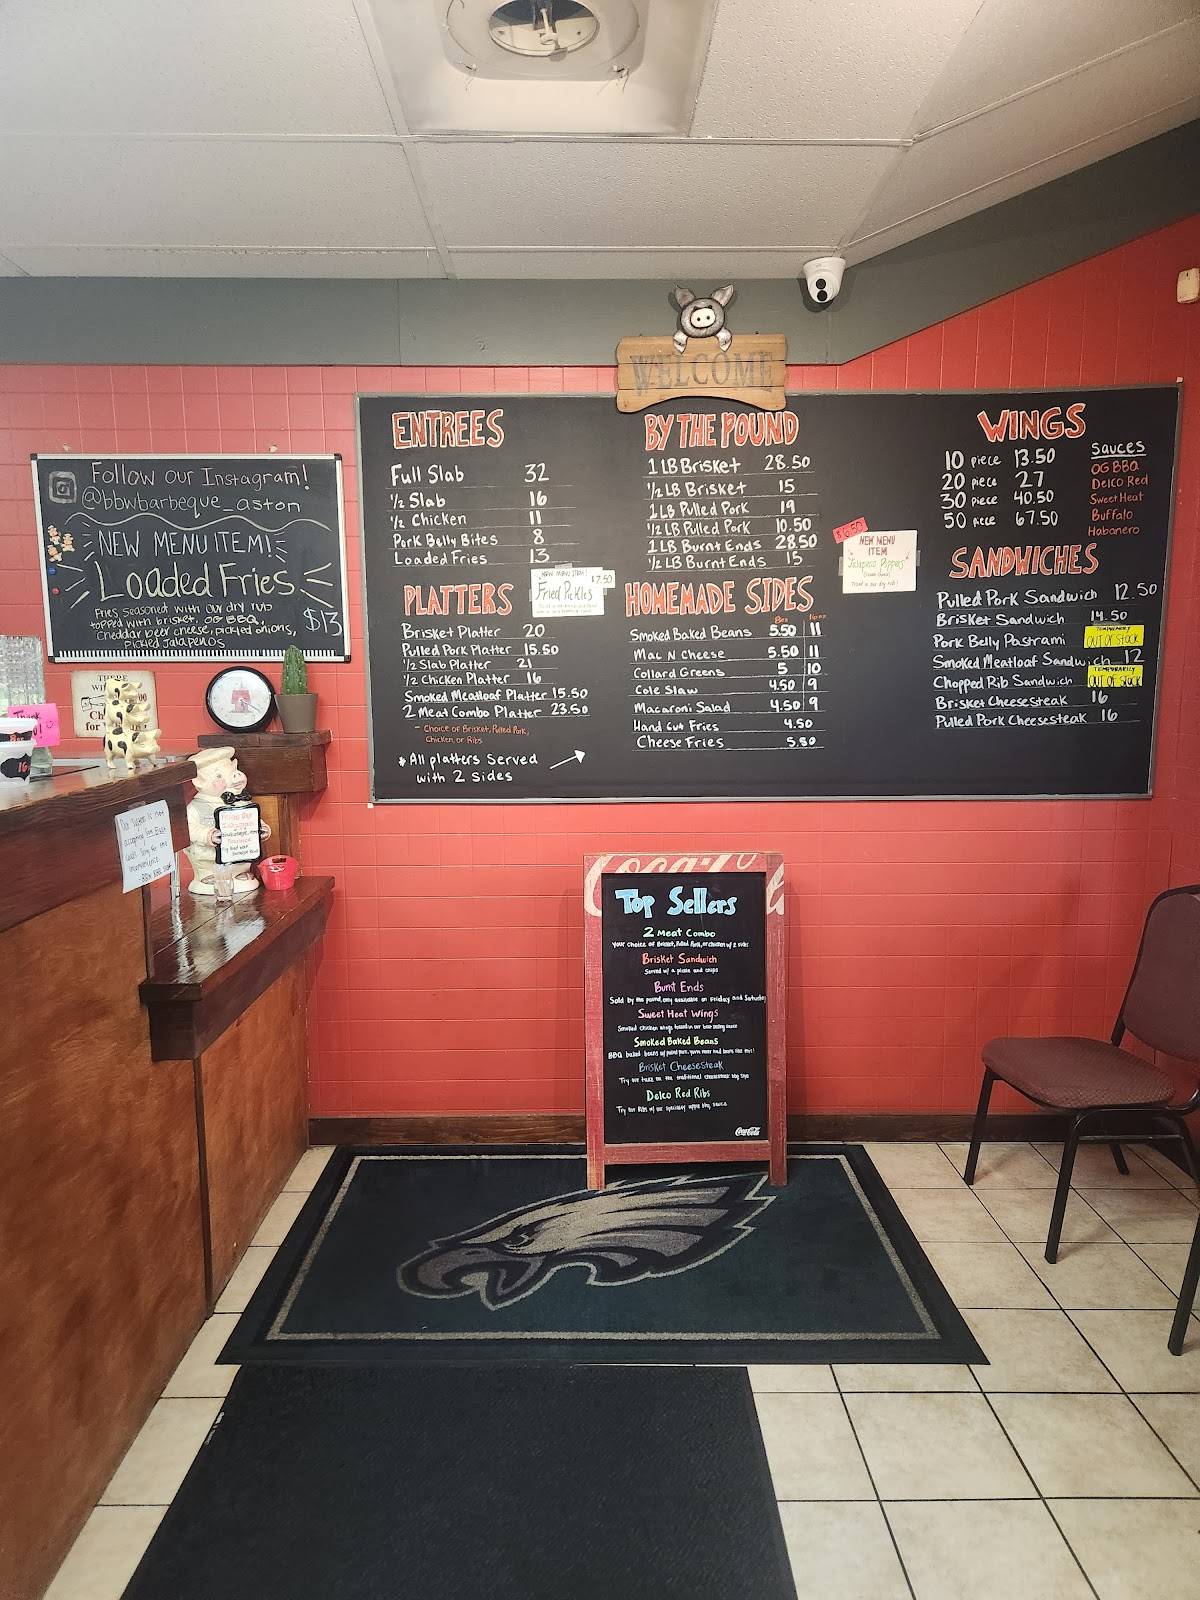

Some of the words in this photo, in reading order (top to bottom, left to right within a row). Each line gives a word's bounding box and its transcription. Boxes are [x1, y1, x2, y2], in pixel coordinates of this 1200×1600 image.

[630, 352, 773, 396] WELCOME
[392, 409, 505, 449] ENTREES
[644, 413, 674, 451] BY
[677, 413, 716, 448] THE
[721, 411, 799, 448] POUND
[977, 402, 1087, 442] WINGS
[648, 457, 658, 475] 1
[661, 458, 677, 474] LB
[680, 457, 741, 474] Brisket
[764, 454, 811, 471] 28.50
[944, 450, 964, 470] 10
[970, 455, 1002, 468] piece
[91, 462, 156, 484] Follow
[164, 469, 193, 484] our
[201, 464, 311, 492] Instagram!
[391, 464, 421, 486] Full
[428, 465, 465, 484] Slab
[524, 463, 550, 483] 32
[941, 473, 965, 490] 20
[1018, 471, 1044, 488] 27
[1092, 477, 1124, 490] Delco
[1127, 475, 1149, 487] Red
[81, 486, 301, 519] @bbwbarbeque_aston
[649, 503, 658, 519] 1
[660, 504, 675, 518] LB
[680, 502, 718, 517] Pulled
[721, 501, 750, 516] Pork
[780, 499, 796, 514] 19
[940, 492, 967, 509] 30
[971, 495, 998, 507] piece
[1013, 491, 1054, 504] 40.50
[392, 533, 422, 548] Pork
[426, 533, 457, 547] Belly
[460, 533, 499, 545] Bites
[533, 528, 544, 545] 8
[1087, 525, 1140, 537] Habanero
[98, 530, 140, 557] NEW
[153, 533, 208, 556] MENU
[214, 533, 273, 558] ITEM!
[648, 539, 658, 553] 1
[660, 539, 677, 553] LB
[681, 539, 721, 553] Burnt
[725, 538, 762, 552] Ends
[775, 534, 818, 549] 28.50
[868, 547, 887, 556] ITEM
[394, 551, 448, 565] Loaded
[451, 550, 488, 565] Fries
[529, 548, 550, 564] 13
[949, 543, 1099, 579] SANDWICHES
[95, 561, 214, 602] Loaded
[219, 563, 295, 597] Fries
[536, 581, 561, 600] Fried
[403, 583, 514, 616] PLATTERS
[625, 581, 736, 617] HOMEMADE
[744, 576, 814, 614] SIDES
[937, 591, 982, 610] Pulled
[986, 589, 1019, 606] Pork
[1024, 586, 1097, 604] Sandwich
[95, 607, 119, 619] Fries
[174, 605, 201, 614] with
[226, 602, 244, 615] dry
[936, 613, 991, 627] Brisket
[995, 614, 1065, 626] Sandwich
[1090, 610, 1127, 622] 14.50
[303, 608, 342, 636] $13
[401, 622, 454, 639] Brisket
[457, 625, 501, 638] Platter
[522, 624, 545, 638] 20
[146, 627, 171, 638] beer
[630, 628, 671, 642] Smoked
[673, 628, 707, 641] Baked
[710, 625, 753, 638] Beans
[769, 624, 796, 637] 5.50
[810, 622, 821, 635] 11
[402, 644, 440, 657] Pulled
[443, 644, 468, 655] Pork
[471, 644, 512, 655] Platter
[524, 643, 559, 656] 15.50
[633, 669, 677, 679] Collard
[679, 668, 725, 678] Greens
[777, 662, 787, 674] 5
[807, 662, 821, 674] 10
[404, 690, 448, 703] Smoked
[451, 689, 502, 702] Meatloaf
[505, 688, 548, 700] Platter
[552, 688, 588, 699] 15.50
[635, 685, 661, 695] Cole
[665, 684, 698, 695] Slaw
[769, 679, 795, 691] 4.50
[808, 678, 817, 690] 9
[935, 696, 986, 710] Brisket
[988, 695, 1068, 707] Cheesesteak
[1091, 690, 1108, 704] 16
[402, 705, 416, 718] 2
[417, 707, 449, 718] Meat
[451, 706, 490, 718] Combo
[494, 704, 542, 718] Platter
[550, 703, 588, 715] 23.50
[86, 722, 100, 731] for
[423, 725, 450, 733] Choice
[492, 726, 511, 734] Pulled
[636, 735, 682, 748] Cheese
[685, 737, 724, 748] Fries
[786, 737, 816, 747] 5.50
[429, 753, 481, 770] platters
[416, 772, 446, 783] with
[453, 770, 465, 783] 2
[615, 889, 655, 918] Top
[667, 886, 737, 915] Sellers
[642, 927, 654, 938] 2
[657, 928, 682, 937] Meat
[686, 929, 716, 938] Combo
[642, 953, 674, 965] Brisket
[678, 953, 717, 963] Sandwich
[654, 982, 676, 992] Burnt
[680, 980, 704, 992] Ends
[637, 1008, 665, 1019] Sweet
[667, 1010, 688, 1018] Heat
[646, 1089, 672, 1102] Delco
[675, 1087, 691, 1099] Red
[694, 1087, 711, 1098] Ribs
